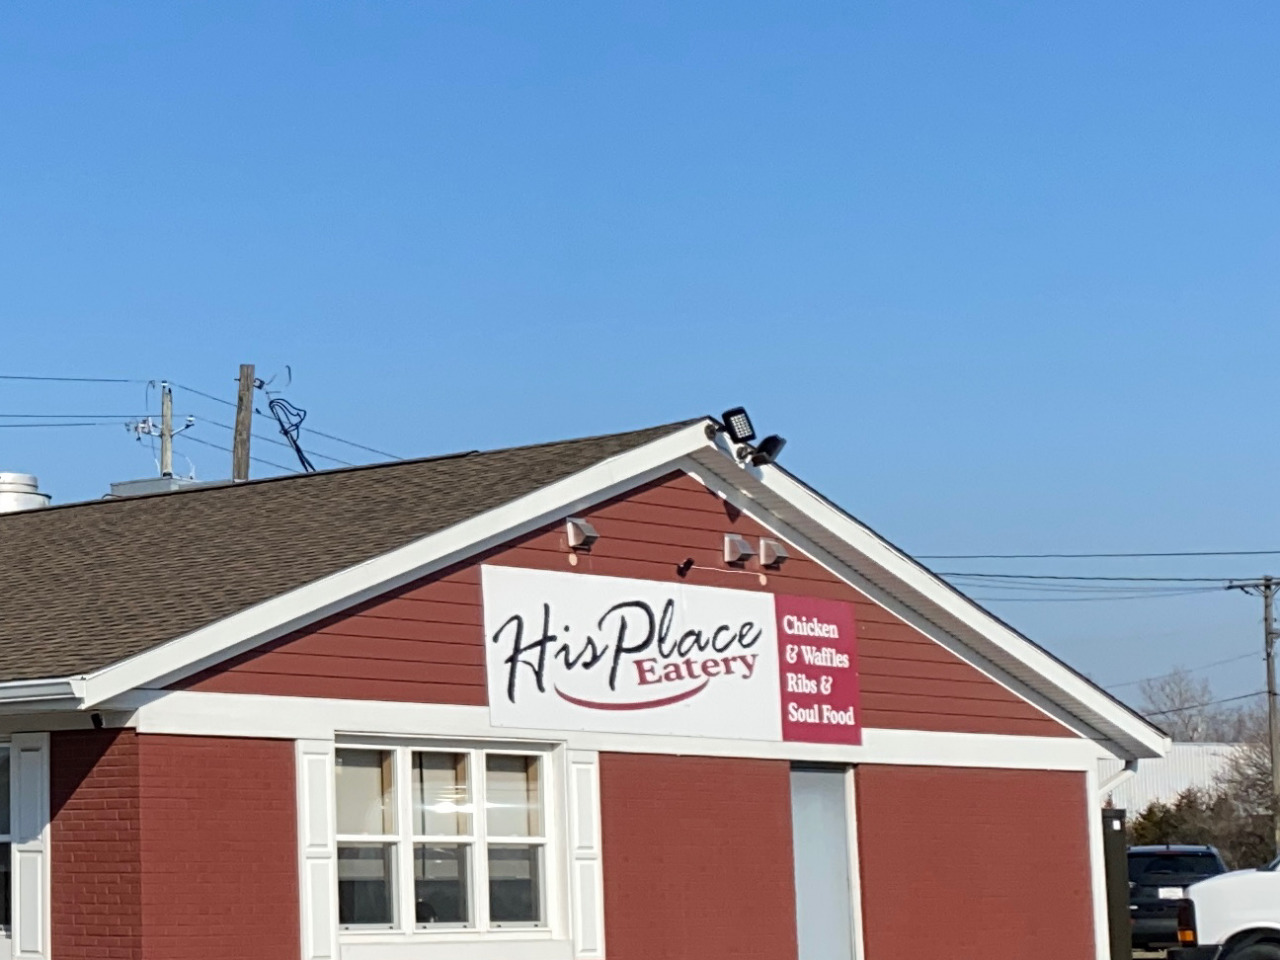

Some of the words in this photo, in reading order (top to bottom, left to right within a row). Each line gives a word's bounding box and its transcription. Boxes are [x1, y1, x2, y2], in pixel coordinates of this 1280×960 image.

[783, 614, 839, 639] Chicken
[493, 602, 607, 704] His
[598, 598, 763, 691] Place
[785, 643, 799, 664] &
[800, 644, 850, 669] Waffles
[631, 653, 760, 686] Eatery
[786, 672, 818, 694] Ribs
[820, 675, 833, 695] &
[788, 701, 820, 724] Soul
[821, 704, 855, 726] Food
